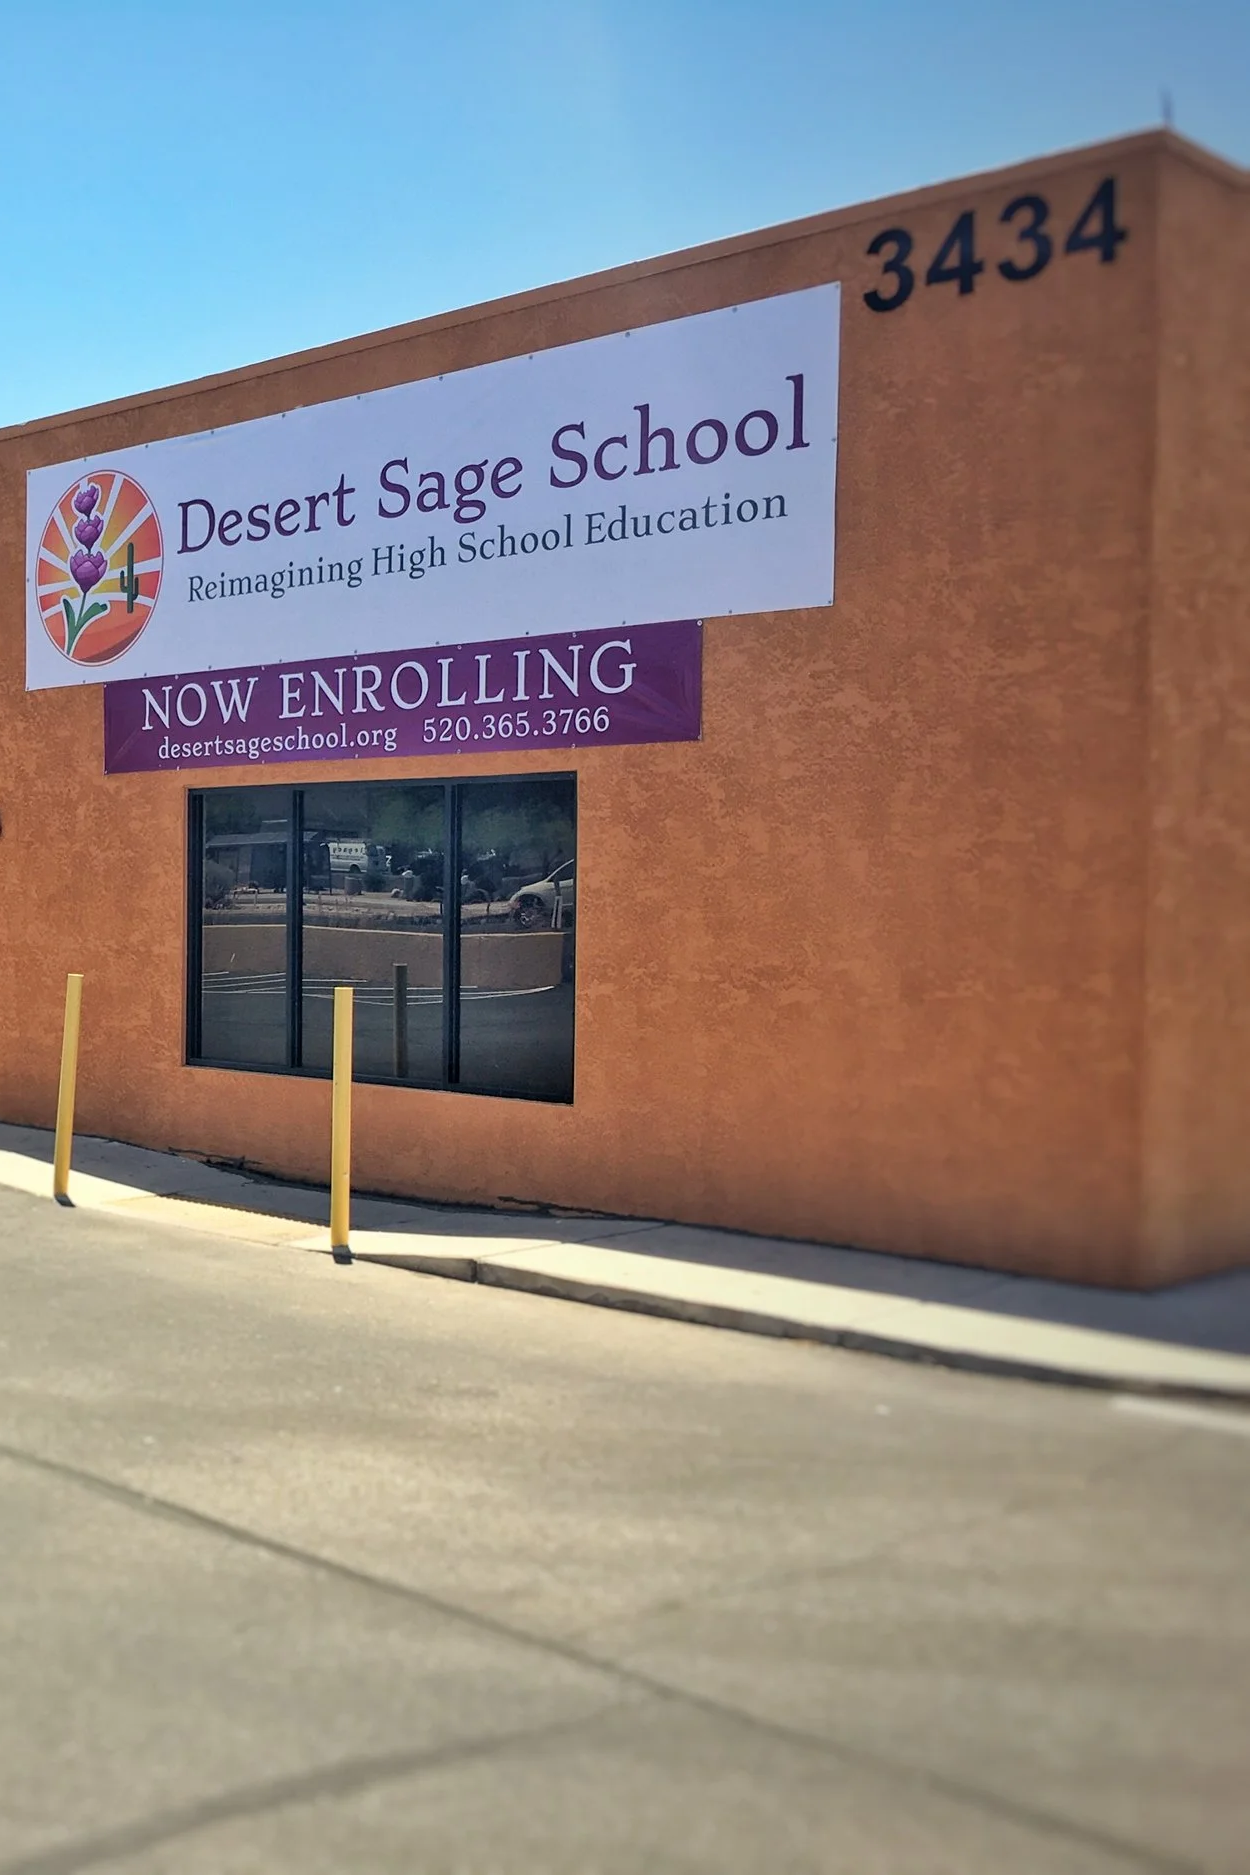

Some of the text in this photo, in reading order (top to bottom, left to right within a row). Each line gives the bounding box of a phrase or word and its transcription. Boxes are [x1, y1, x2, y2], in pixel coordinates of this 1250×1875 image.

[863, 176, 1127, 312] 3434
[177, 373, 810, 554] Desert Sage School
[188, 493, 788, 602] Reimagining High School Education
[141, 639, 637, 730] NOW ENROLLING
[158, 706, 610, 760] desertsageschool.org 520.365.3766
